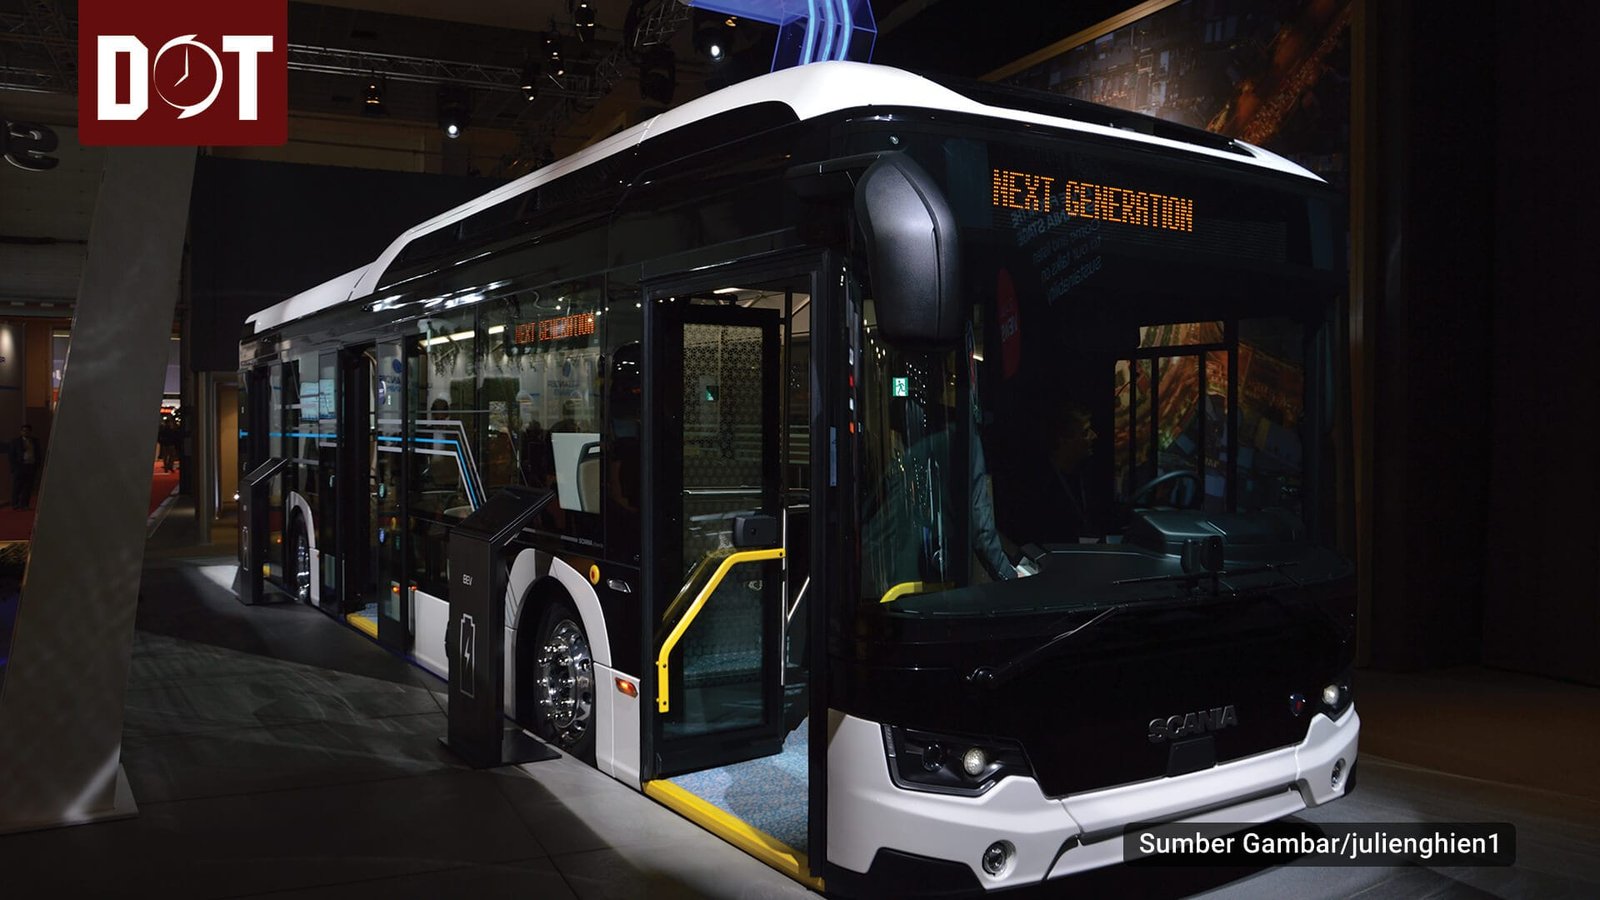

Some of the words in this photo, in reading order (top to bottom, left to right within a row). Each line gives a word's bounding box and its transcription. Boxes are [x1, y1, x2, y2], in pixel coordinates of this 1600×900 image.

[992, 168, 1055, 213] NEXT
[1065, 180, 1195, 233] GENERATION
[515, 322, 536, 345] NEXT
[538, 312, 595, 342] GENERATION
[462, 573, 474, 586] BEV
[1147, 705, 1239, 744] SCANIA
